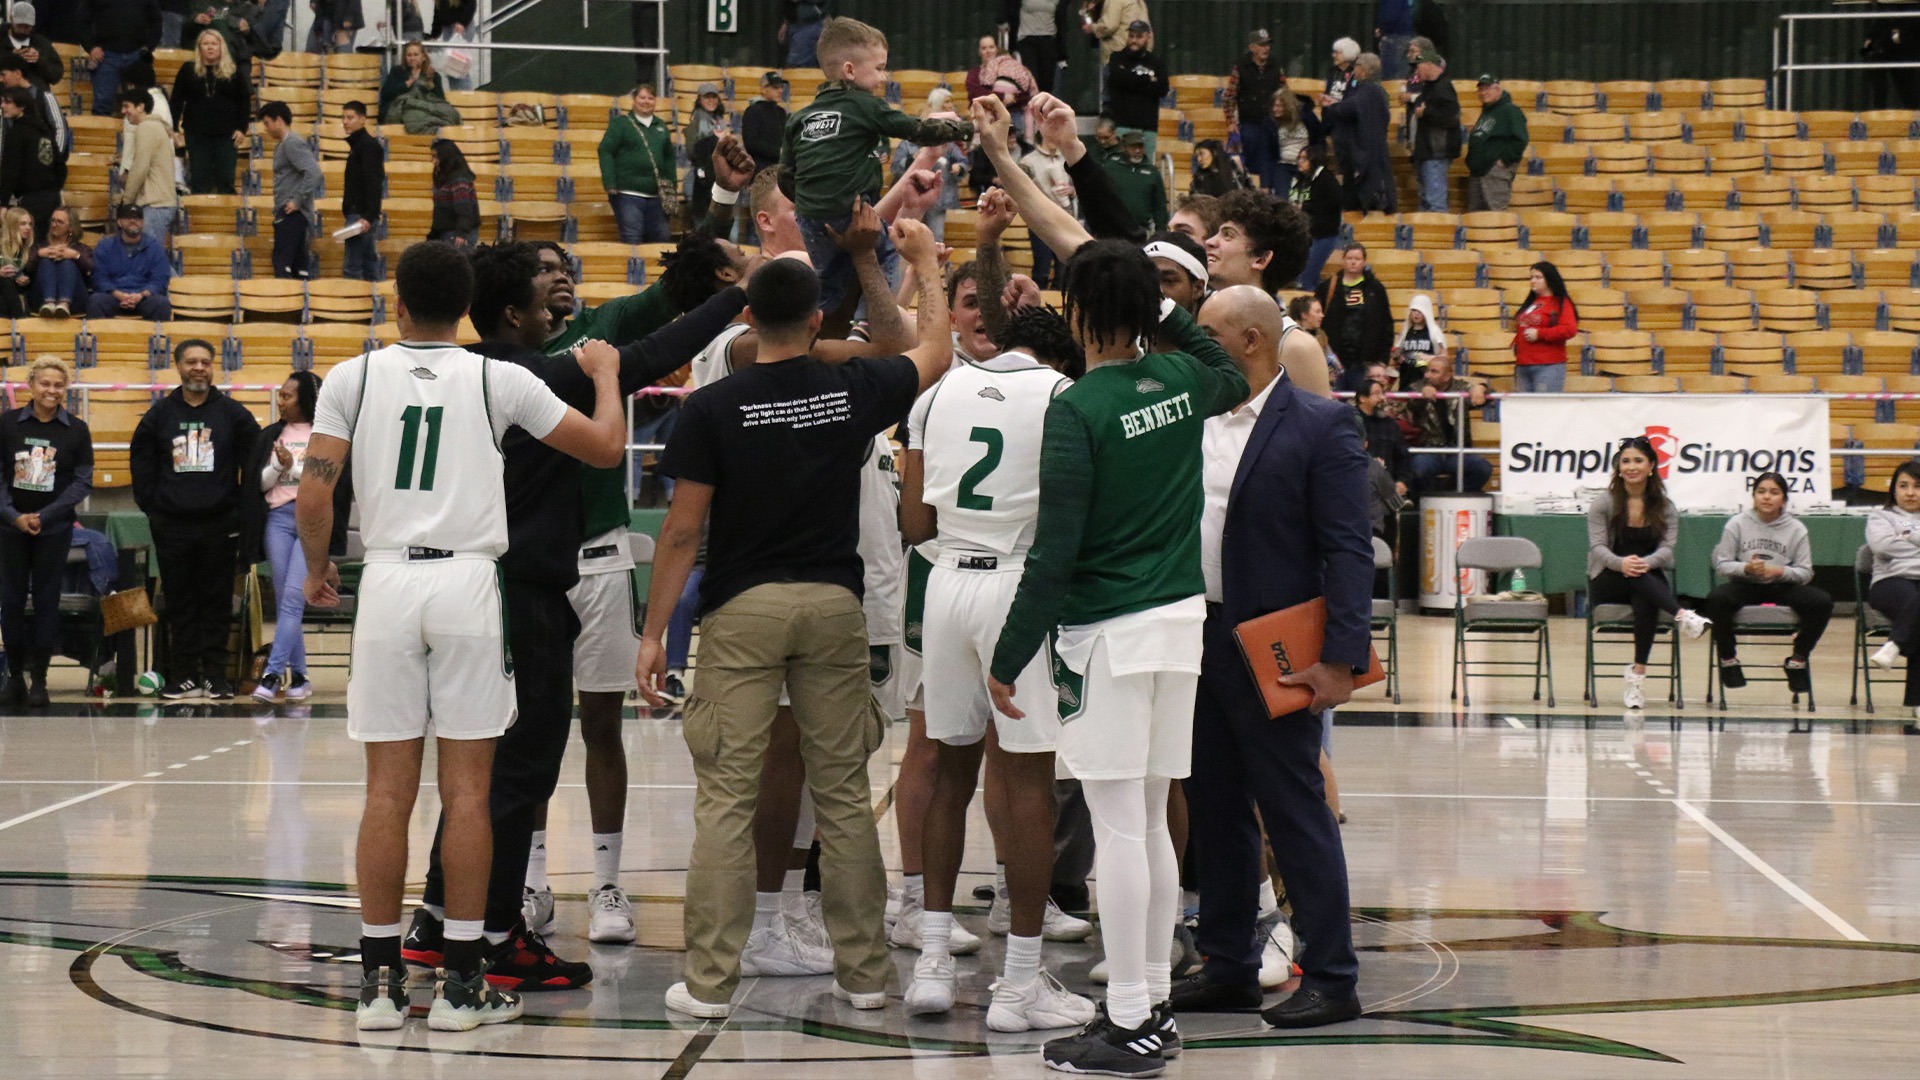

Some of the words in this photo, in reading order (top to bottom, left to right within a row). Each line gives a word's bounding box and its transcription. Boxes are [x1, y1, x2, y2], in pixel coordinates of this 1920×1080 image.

[716, 0, 732, 30] B
[746, 412, 759, 420] only
[760, 409, 775, 418] light
[794, 406, 809, 414] that.
[810, 403, 825, 411] Hate
[826, 398, 847, 407] cannot
[792, 398, 808, 406] drive
[809, 395, 820, 403] out
[743, 420, 759, 428] drive
[786, 415, 798, 423] only
[799, 413, 812, 421] love
[813, 417, 831, 426] Luther
[832, 415, 846, 423] King
[1120, 391, 1193, 440] BENNETT
[394, 405, 444, 492] 11
[1677, 442, 1816, 475] Simon's
[956, 426, 1004, 511] 2
[1746, 476, 1816, 493] PZA
[1742, 538, 1787, 558] CALIFORNIA
